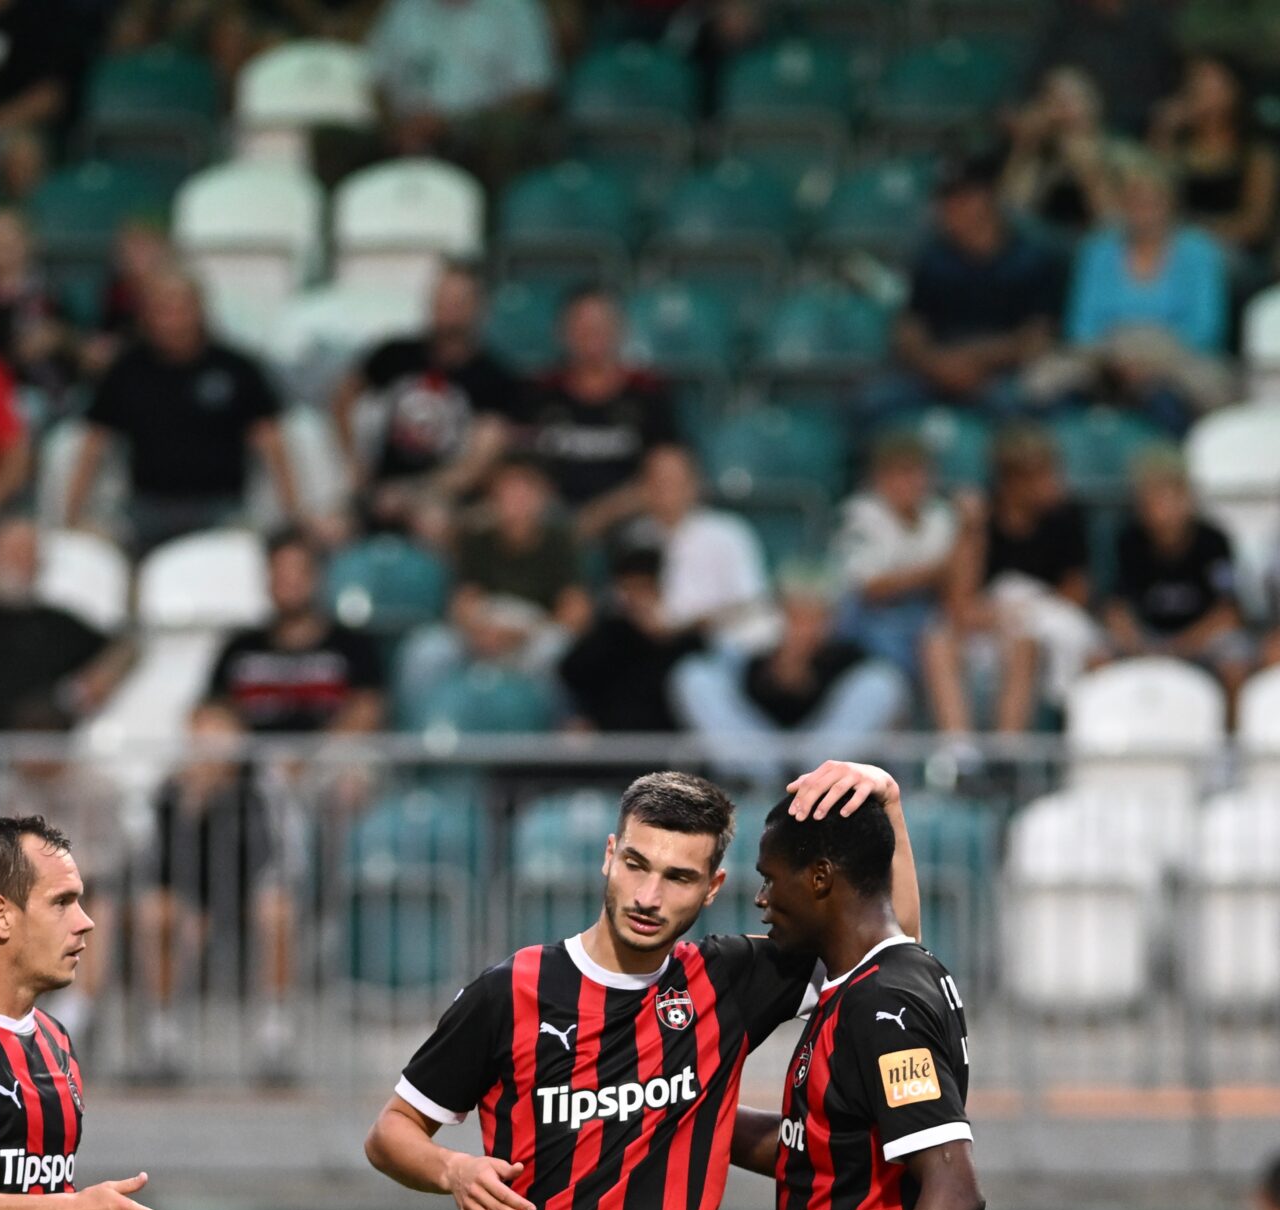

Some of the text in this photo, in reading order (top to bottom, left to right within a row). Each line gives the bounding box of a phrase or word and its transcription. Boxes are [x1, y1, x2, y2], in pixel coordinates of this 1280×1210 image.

[888, 1057, 931, 1084] niké
[536, 1065, 697, 1129] Tipsport
[892, 1078, 937, 1101] LIGA
